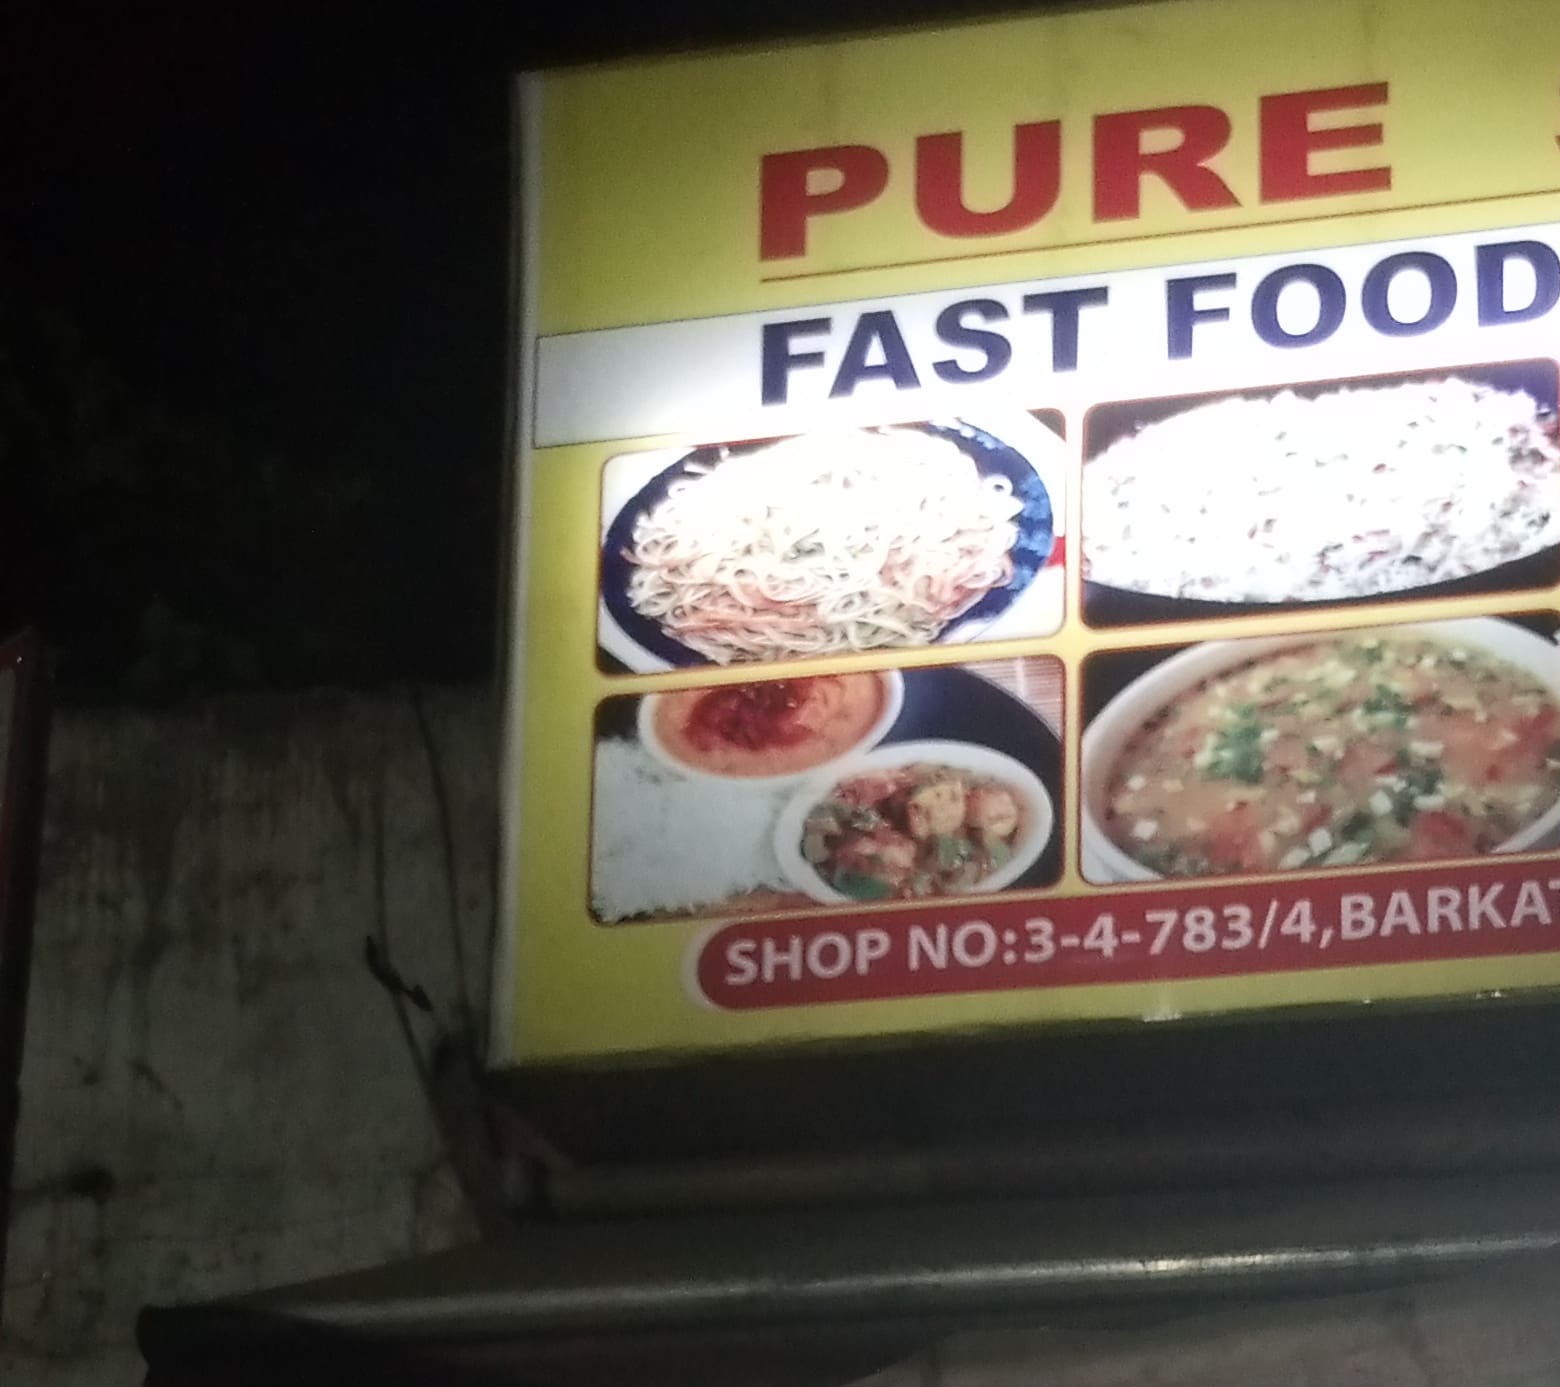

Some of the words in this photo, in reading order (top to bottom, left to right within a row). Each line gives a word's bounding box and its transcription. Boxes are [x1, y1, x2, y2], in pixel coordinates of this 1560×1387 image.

[759, 81, 1391, 263] PURE
[759, 286, 1109, 406] FAST
[725, 930, 890, 987] SHOP
